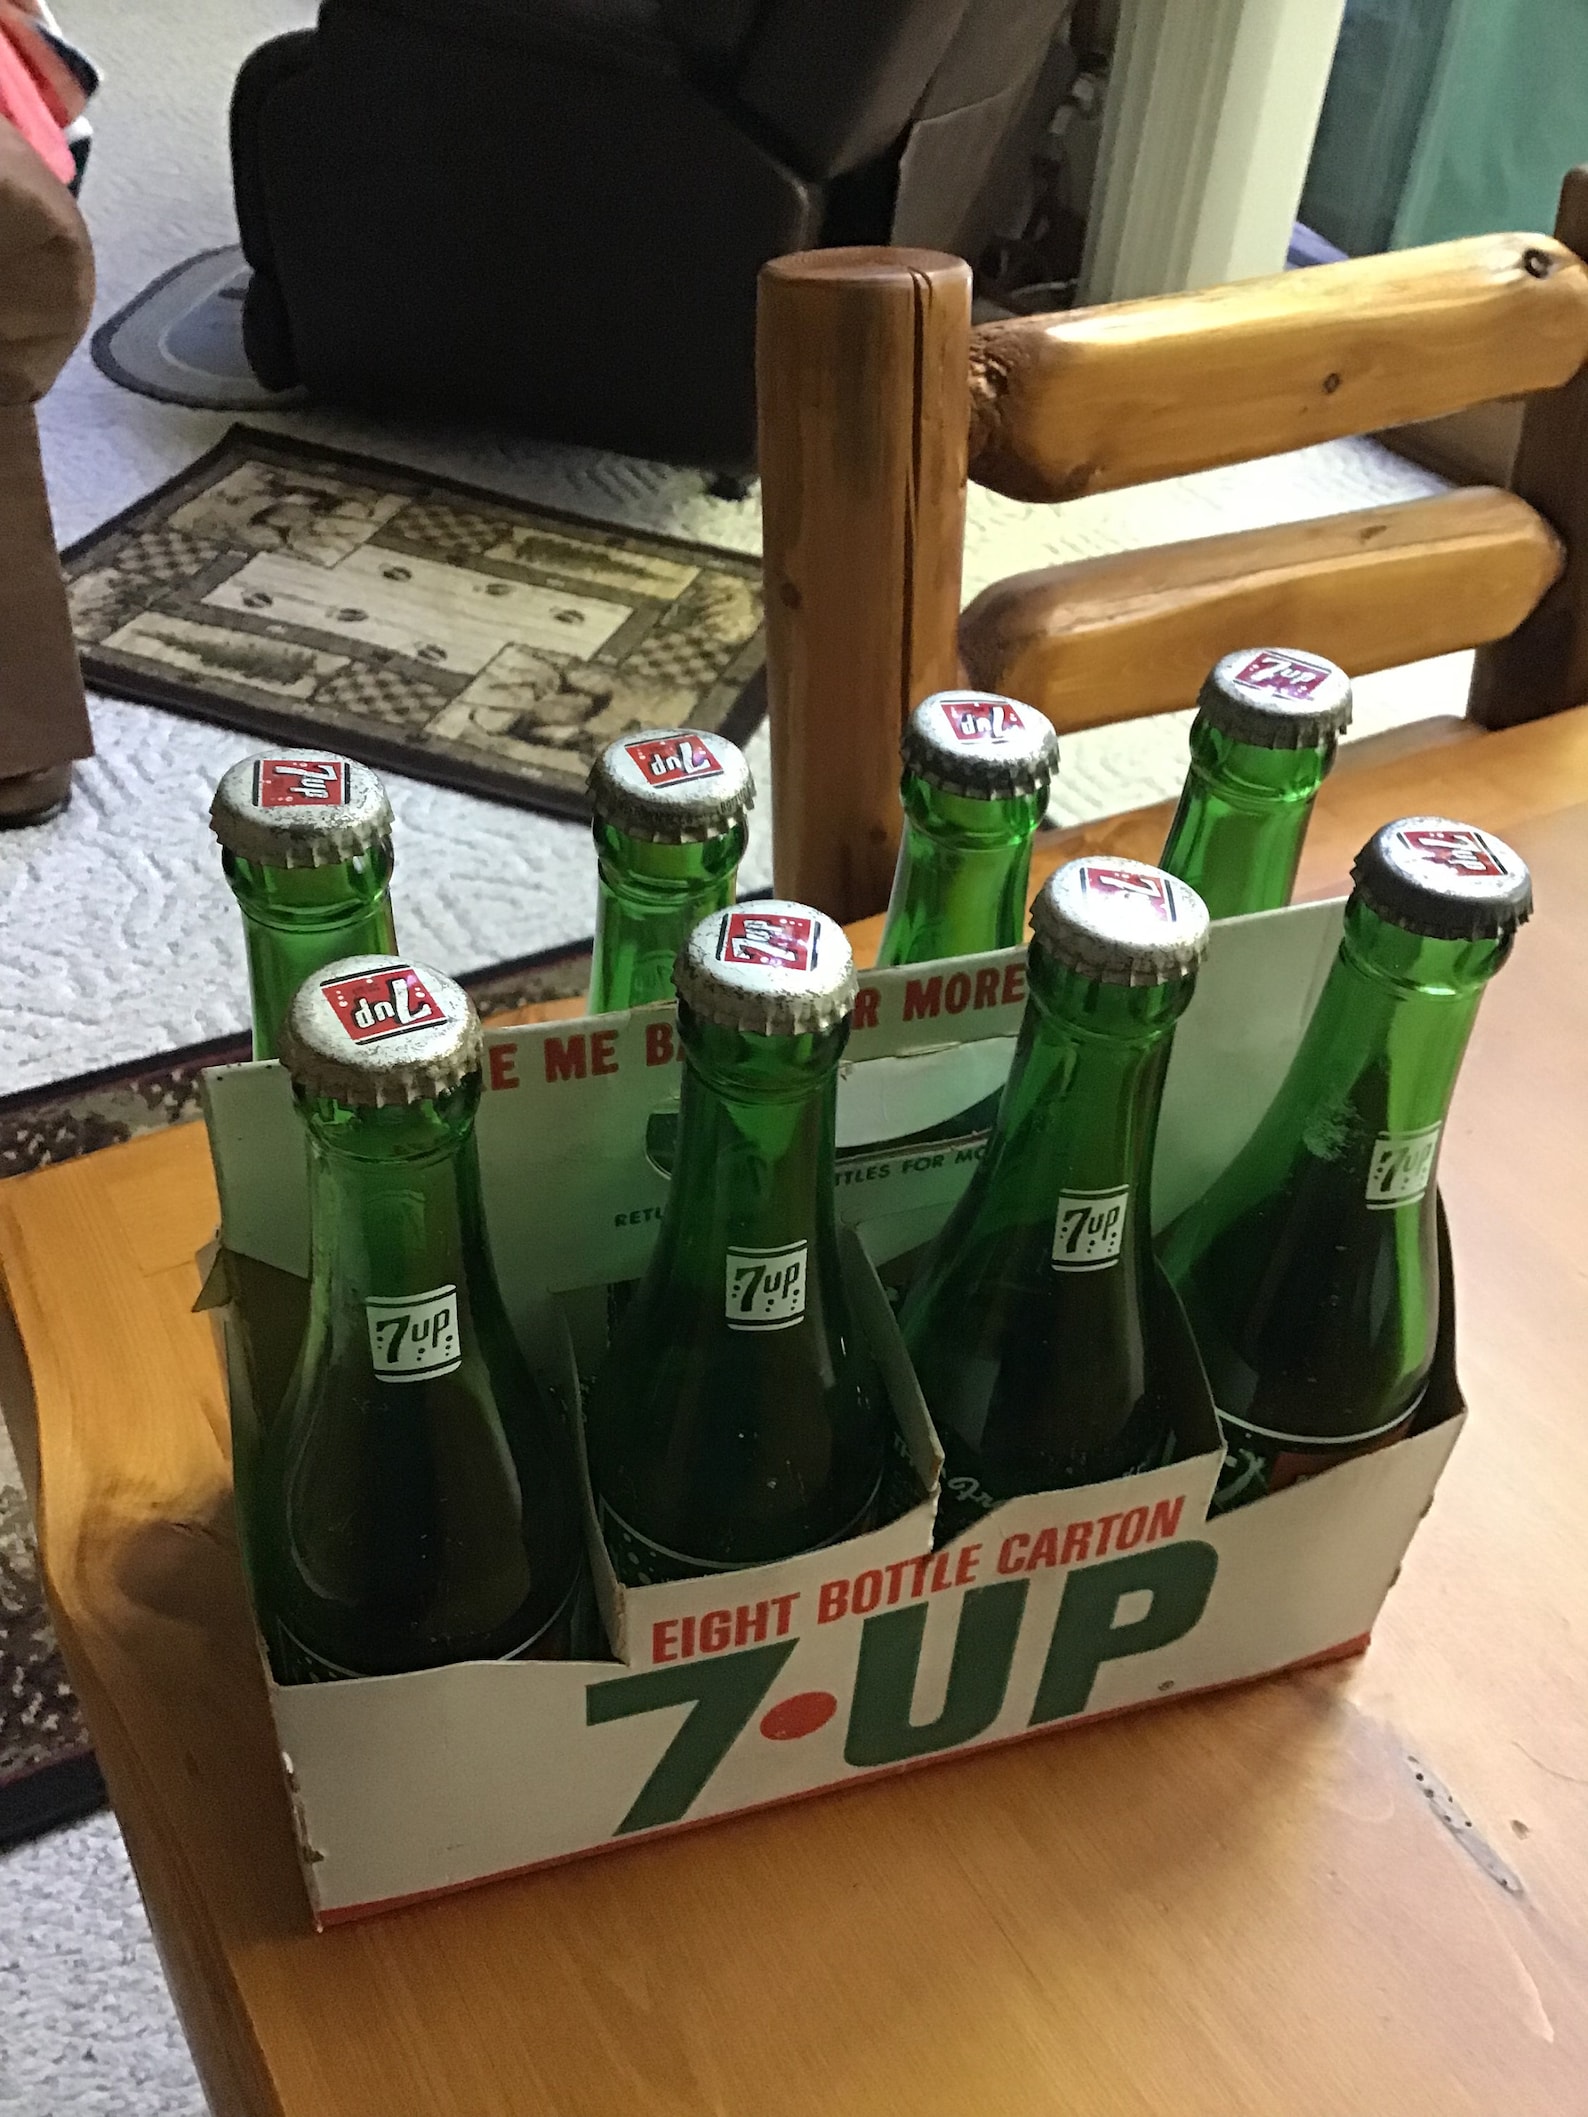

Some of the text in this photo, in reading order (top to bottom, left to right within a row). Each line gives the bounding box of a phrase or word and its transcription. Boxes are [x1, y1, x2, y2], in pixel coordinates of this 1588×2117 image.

[544, 1029, 619, 1083] ME
[902, 962, 1027, 1023] MORE
[834, 1163, 891, 1187] TTLES
[901, 1154, 945, 1175] FOR
[650, 1495, 1186, 1664] EIGHT BOTTLE CARTON
